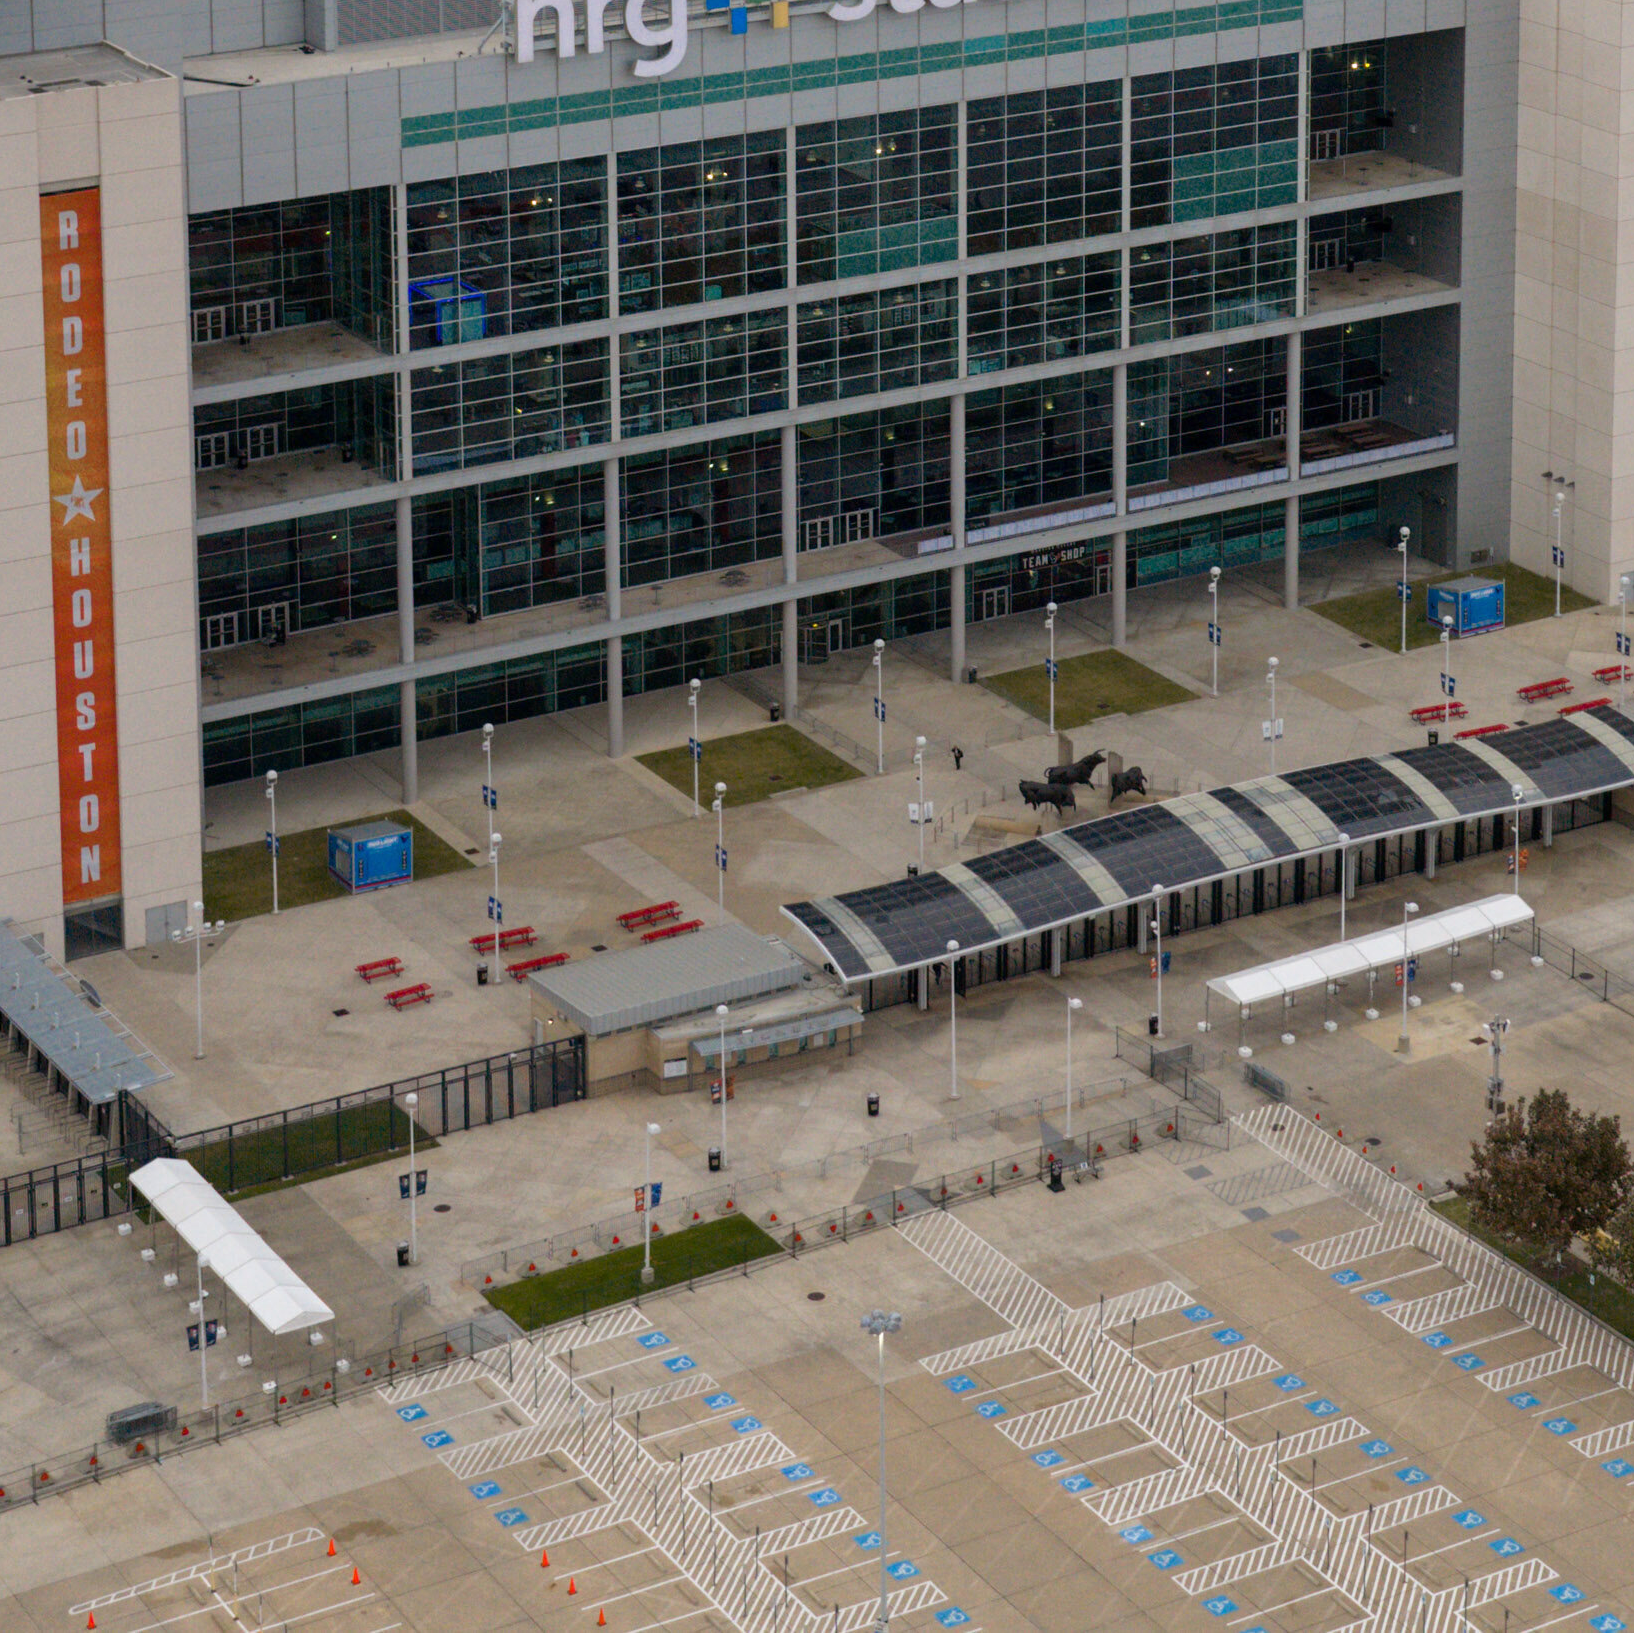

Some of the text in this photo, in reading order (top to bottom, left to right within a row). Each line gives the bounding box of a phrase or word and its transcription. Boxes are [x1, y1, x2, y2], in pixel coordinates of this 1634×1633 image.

[58, 210, 87, 460] RODEO
[1022, 553, 1049, 569] TEAM
[1061, 546, 1085, 561] SHOP
[69, 538, 101, 884] HOUSTON
